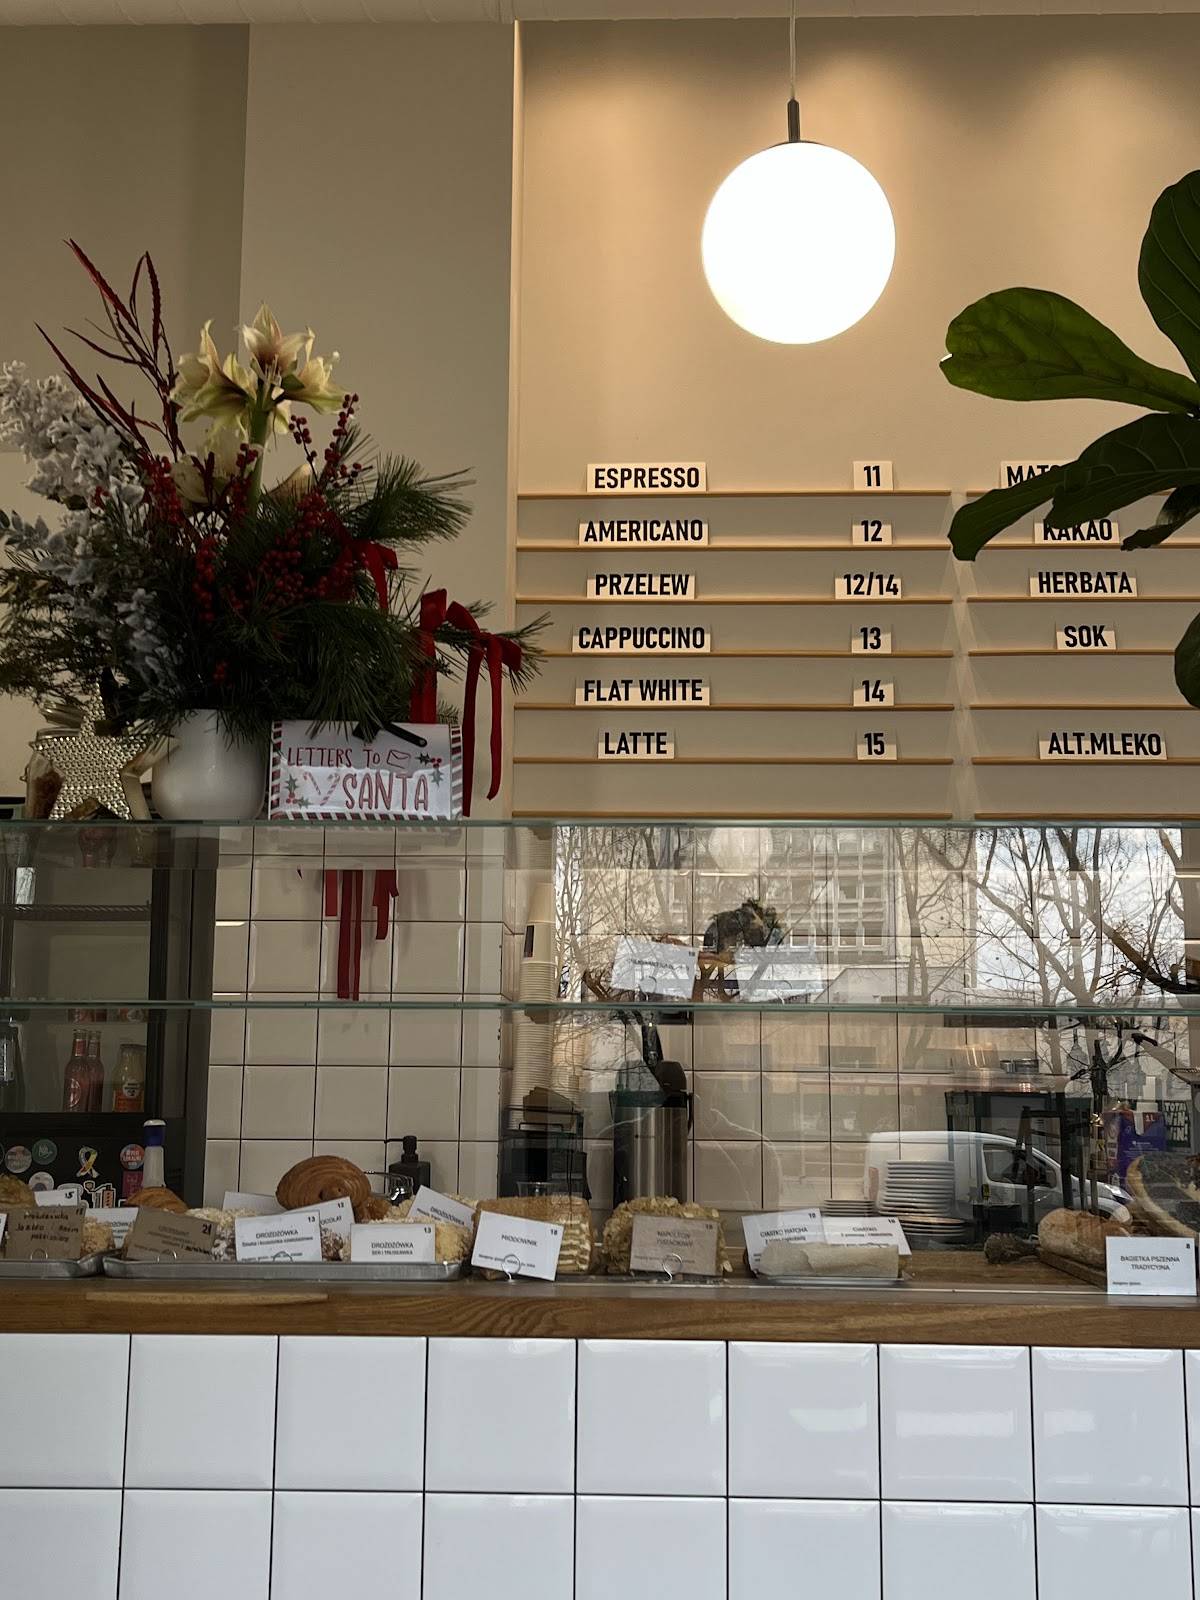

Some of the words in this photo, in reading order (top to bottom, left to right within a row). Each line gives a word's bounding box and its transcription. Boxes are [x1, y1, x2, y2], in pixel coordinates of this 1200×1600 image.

[594, 467, 700, 488] ESPRESSO
[863, 466, 881, 487] 11
[584, 519, 703, 542] AMERICANO
[860, 520, 882, 542] 12
[1043, 519, 1112, 540] KAKAO
[595, 574, 690, 595] PRZELEW
[843, 573, 899, 596] 12/14
[1038, 572, 1133, 594] HERBATA
[578, 627, 705, 649] CAPPUCCINO
[860, 627, 881, 649] 13
[1064, 625, 1108, 647] SOK
[584, 679, 633, 701] FLAT
[639, 679, 703, 701] WHITE
[861, 680, 885, 702] 14
[604, 732, 667, 755] LATTE
[864, 732, 885, 755] 15
[1048, 732, 1162, 756] ALT.MLEKO
[287, 747, 353, 768] LETTERS
[342, 771, 428, 811] SANTA
